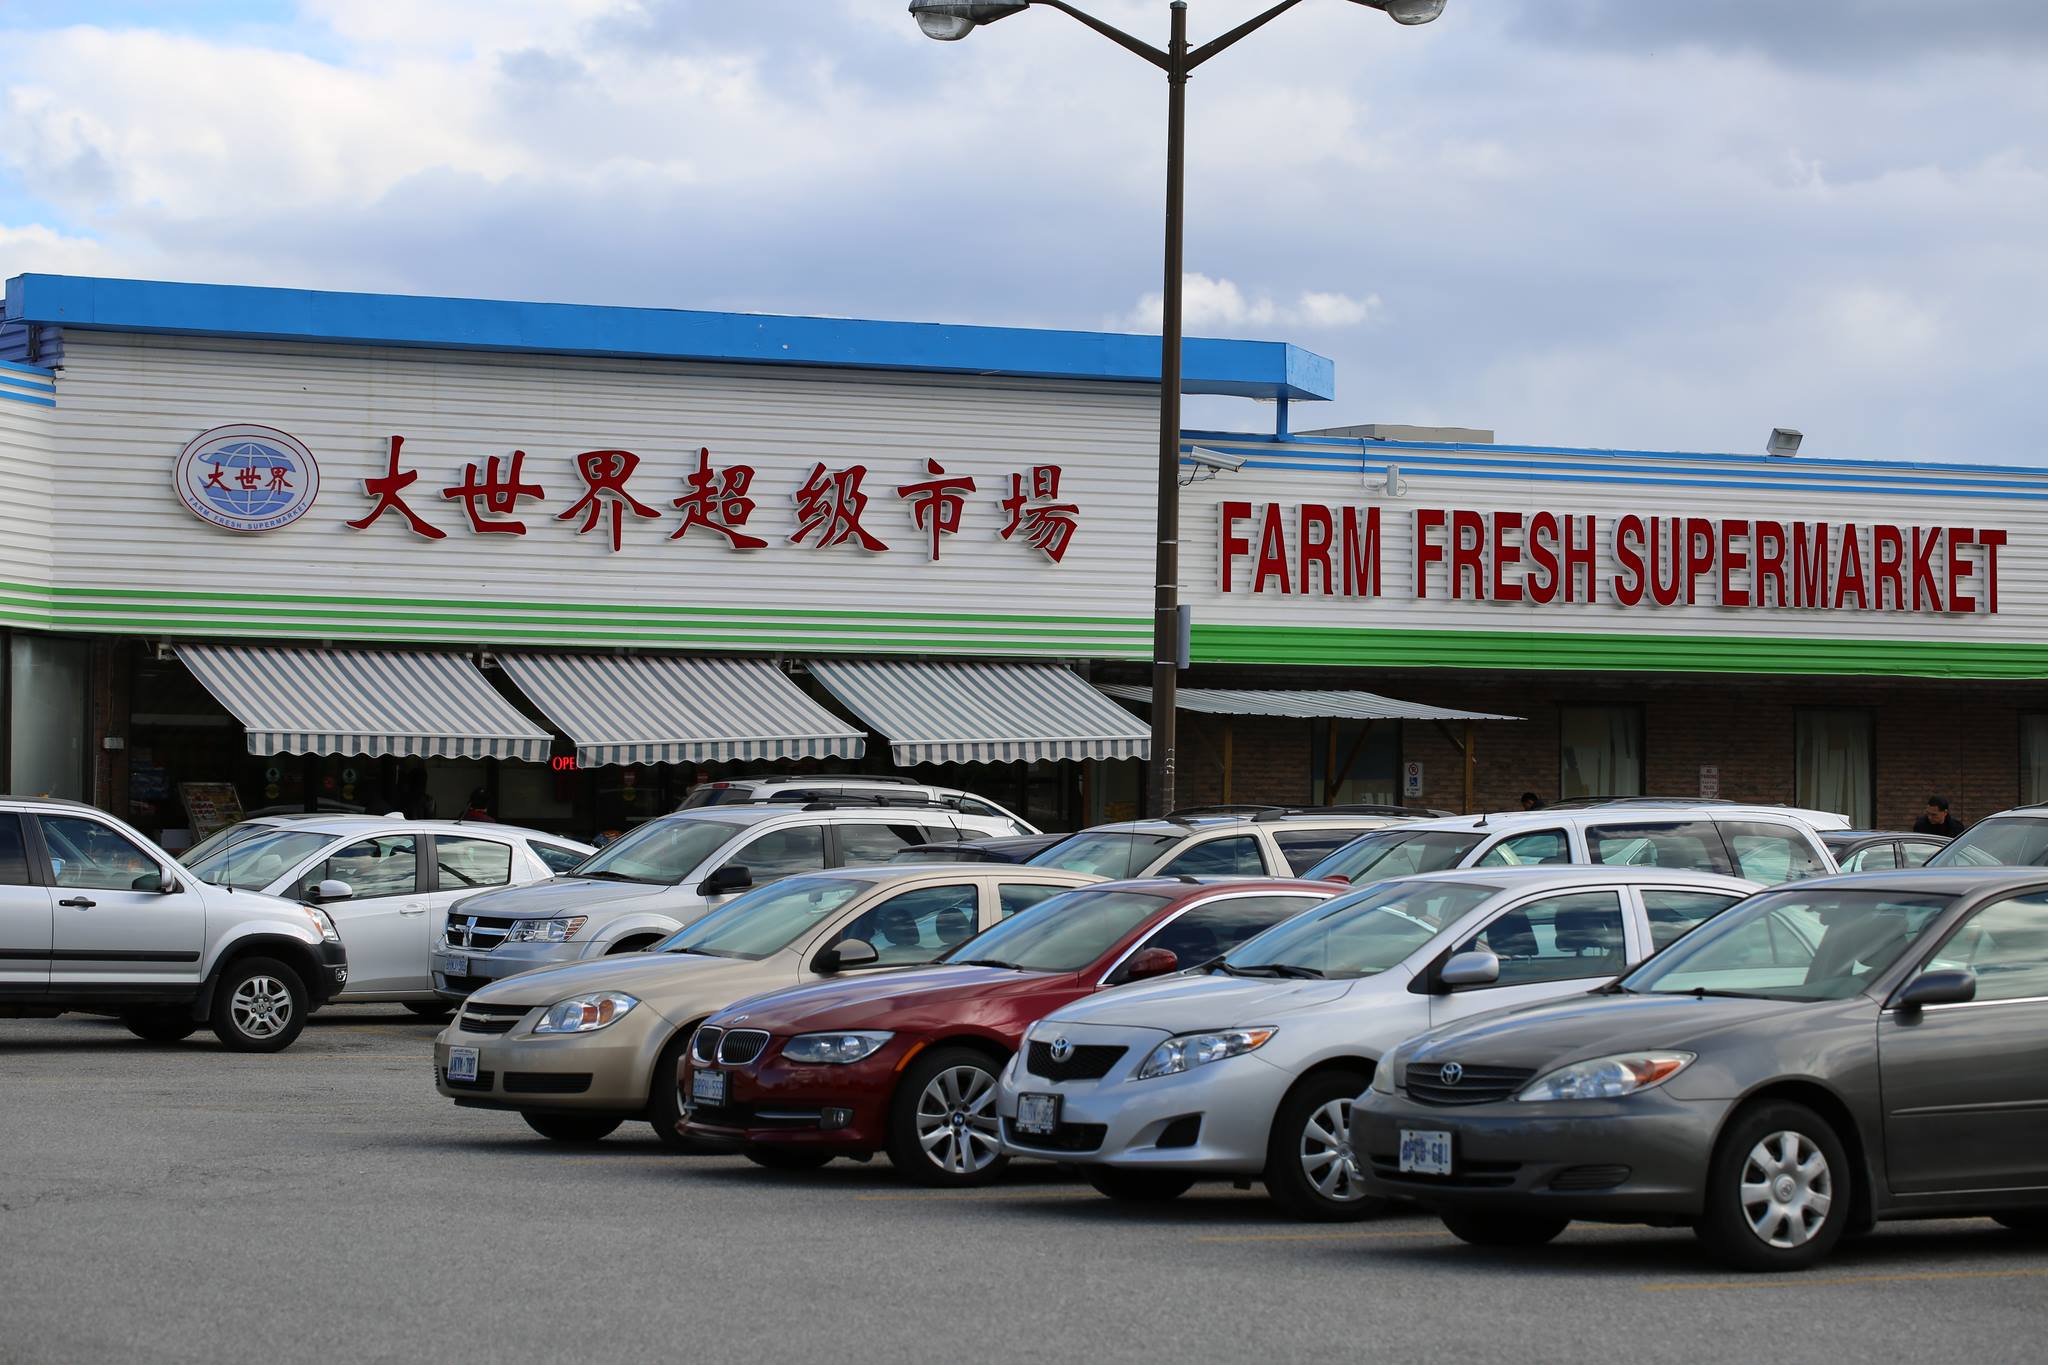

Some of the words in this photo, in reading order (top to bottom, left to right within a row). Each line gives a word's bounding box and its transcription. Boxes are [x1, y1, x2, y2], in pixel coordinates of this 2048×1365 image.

[204, 461, 294, 495] 大世界
[188, 497, 210, 519] FARM
[214, 515, 242, 529] FRESH
[247, 502, 308, 530] SUPERMARKET
[1220, 501, 1381, 597] FARM
[1413, 508, 1597, 605] FRESH
[1612, 514, 2008, 614] SUPERMARKET
[552, 756, 576, 771] OPE
